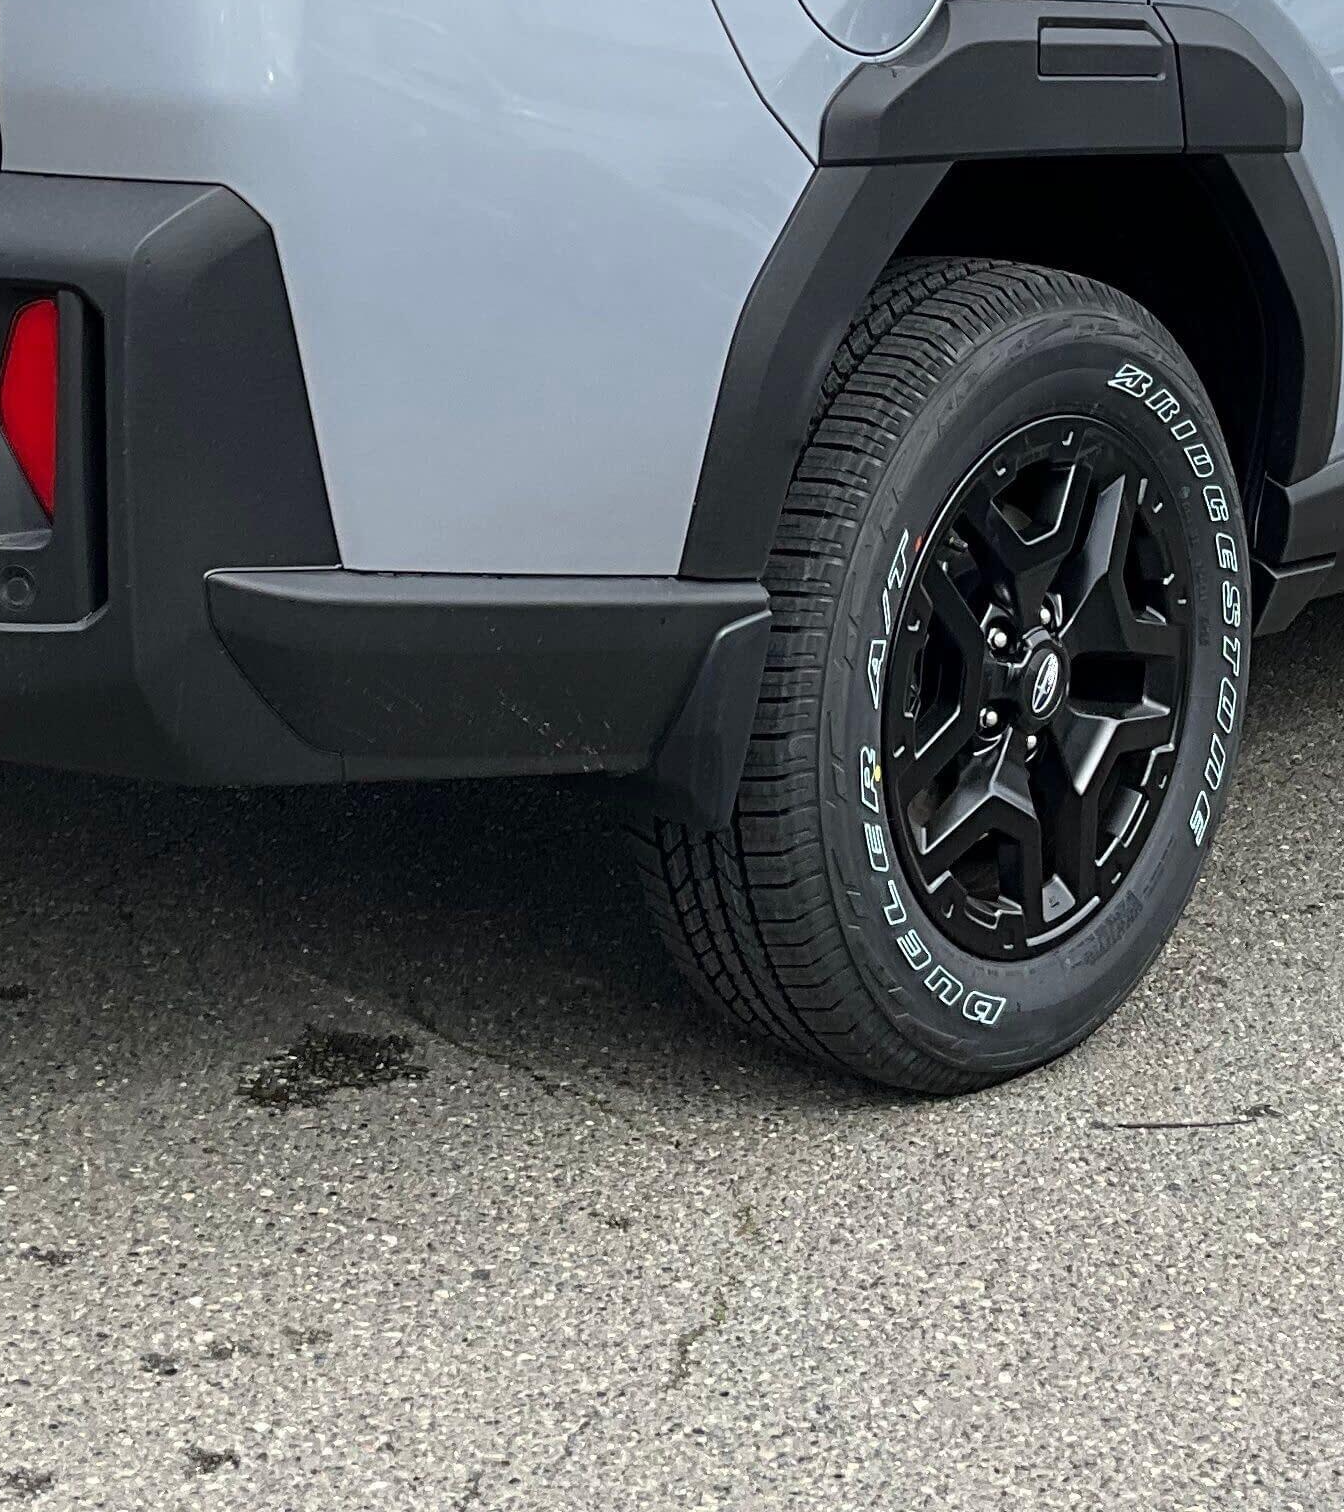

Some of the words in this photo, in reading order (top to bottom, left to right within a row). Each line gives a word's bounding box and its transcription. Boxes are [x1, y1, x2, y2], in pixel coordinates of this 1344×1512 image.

[867, 529, 911, 710] A/T
[1106, 362, 1242, 849] BRIDGESTONE
[859, 742, 1008, 1028] DUELER
